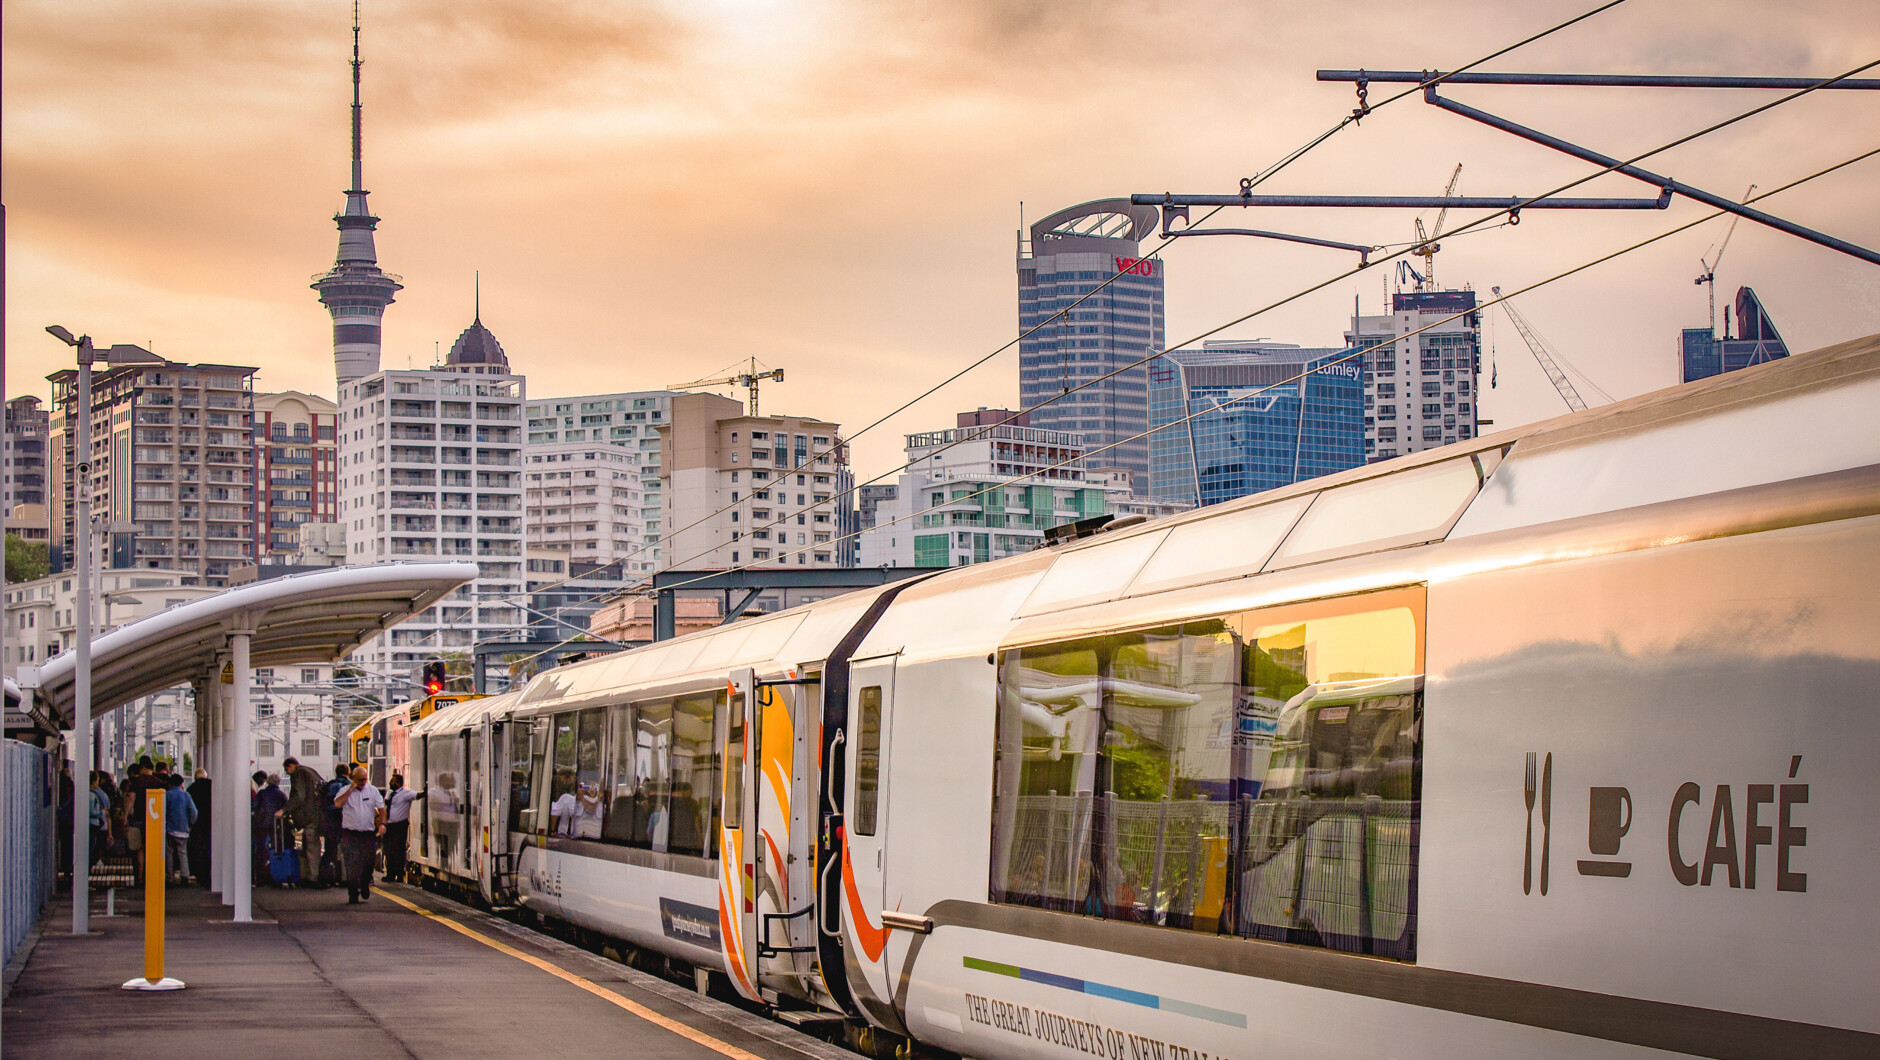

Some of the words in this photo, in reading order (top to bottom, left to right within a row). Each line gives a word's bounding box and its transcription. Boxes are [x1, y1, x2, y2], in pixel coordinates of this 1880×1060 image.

[1316, 361, 1360, 381] Lumley
[1667, 754, 1809, 893] CAFÉ
[965, 992, 991, 1026] THE
[991, 998, 1032, 1037] GREAT
[1034, 1009, 1105, 1058] JOURNEYS
[1106, 1027, 1125, 1060] OF
[1128, 1033, 1165, 1060] NEW
